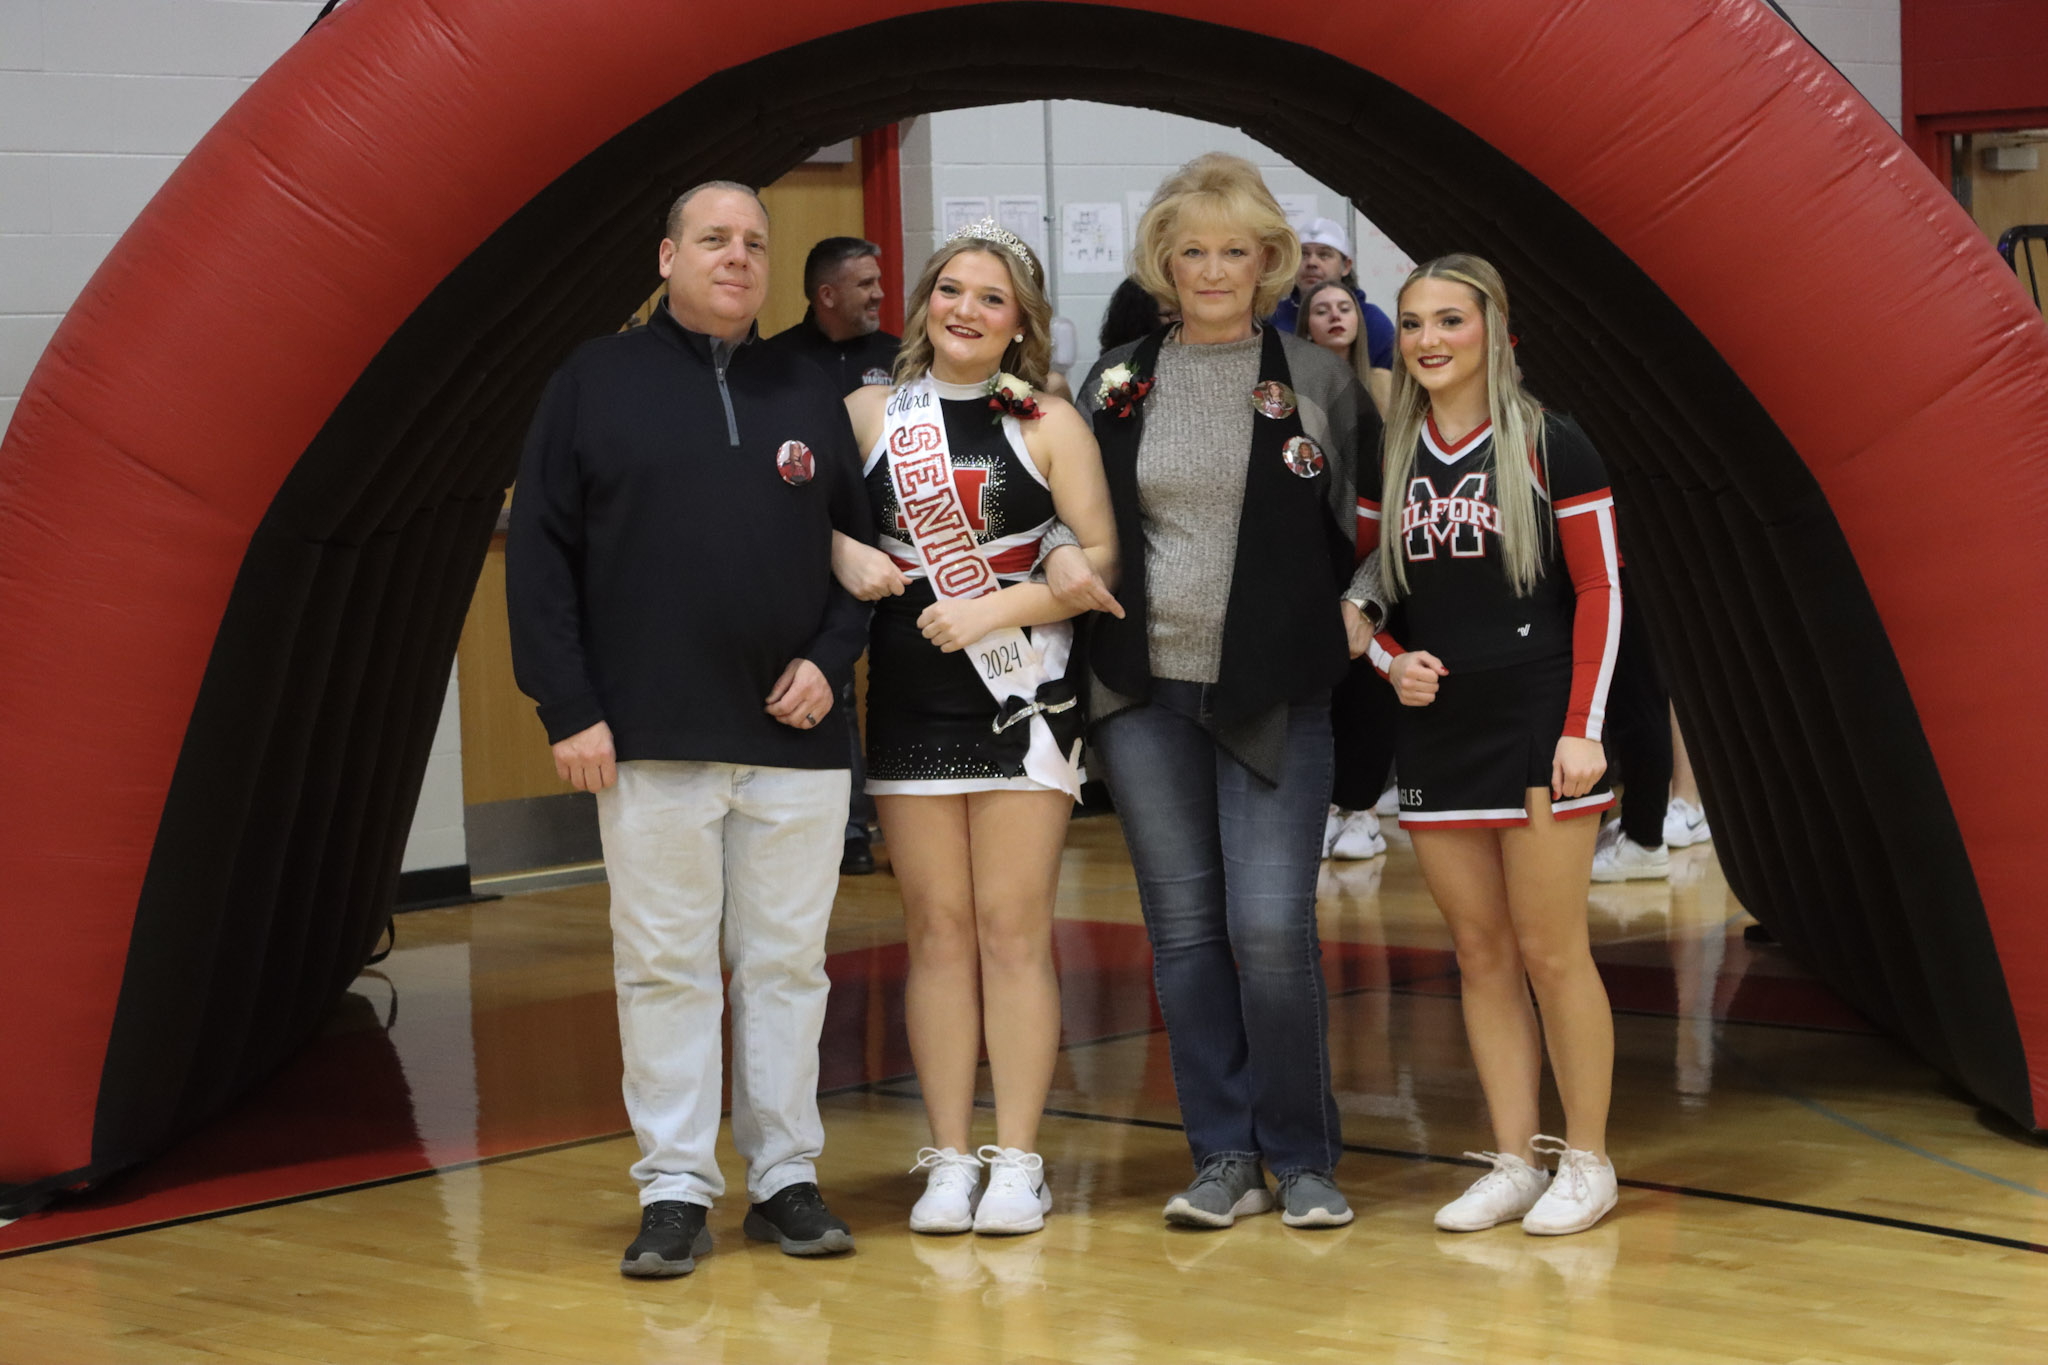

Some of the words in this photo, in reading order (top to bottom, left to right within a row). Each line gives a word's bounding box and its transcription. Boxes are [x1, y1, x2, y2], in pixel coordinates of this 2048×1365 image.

[887, 386, 931, 416] Alexa
[889, 422, 998, 599] SENIO
[1400, 497, 1506, 536] ILFOR
[1405, 472, 1489, 562] M
[980, 641, 1022, 680] 2024
